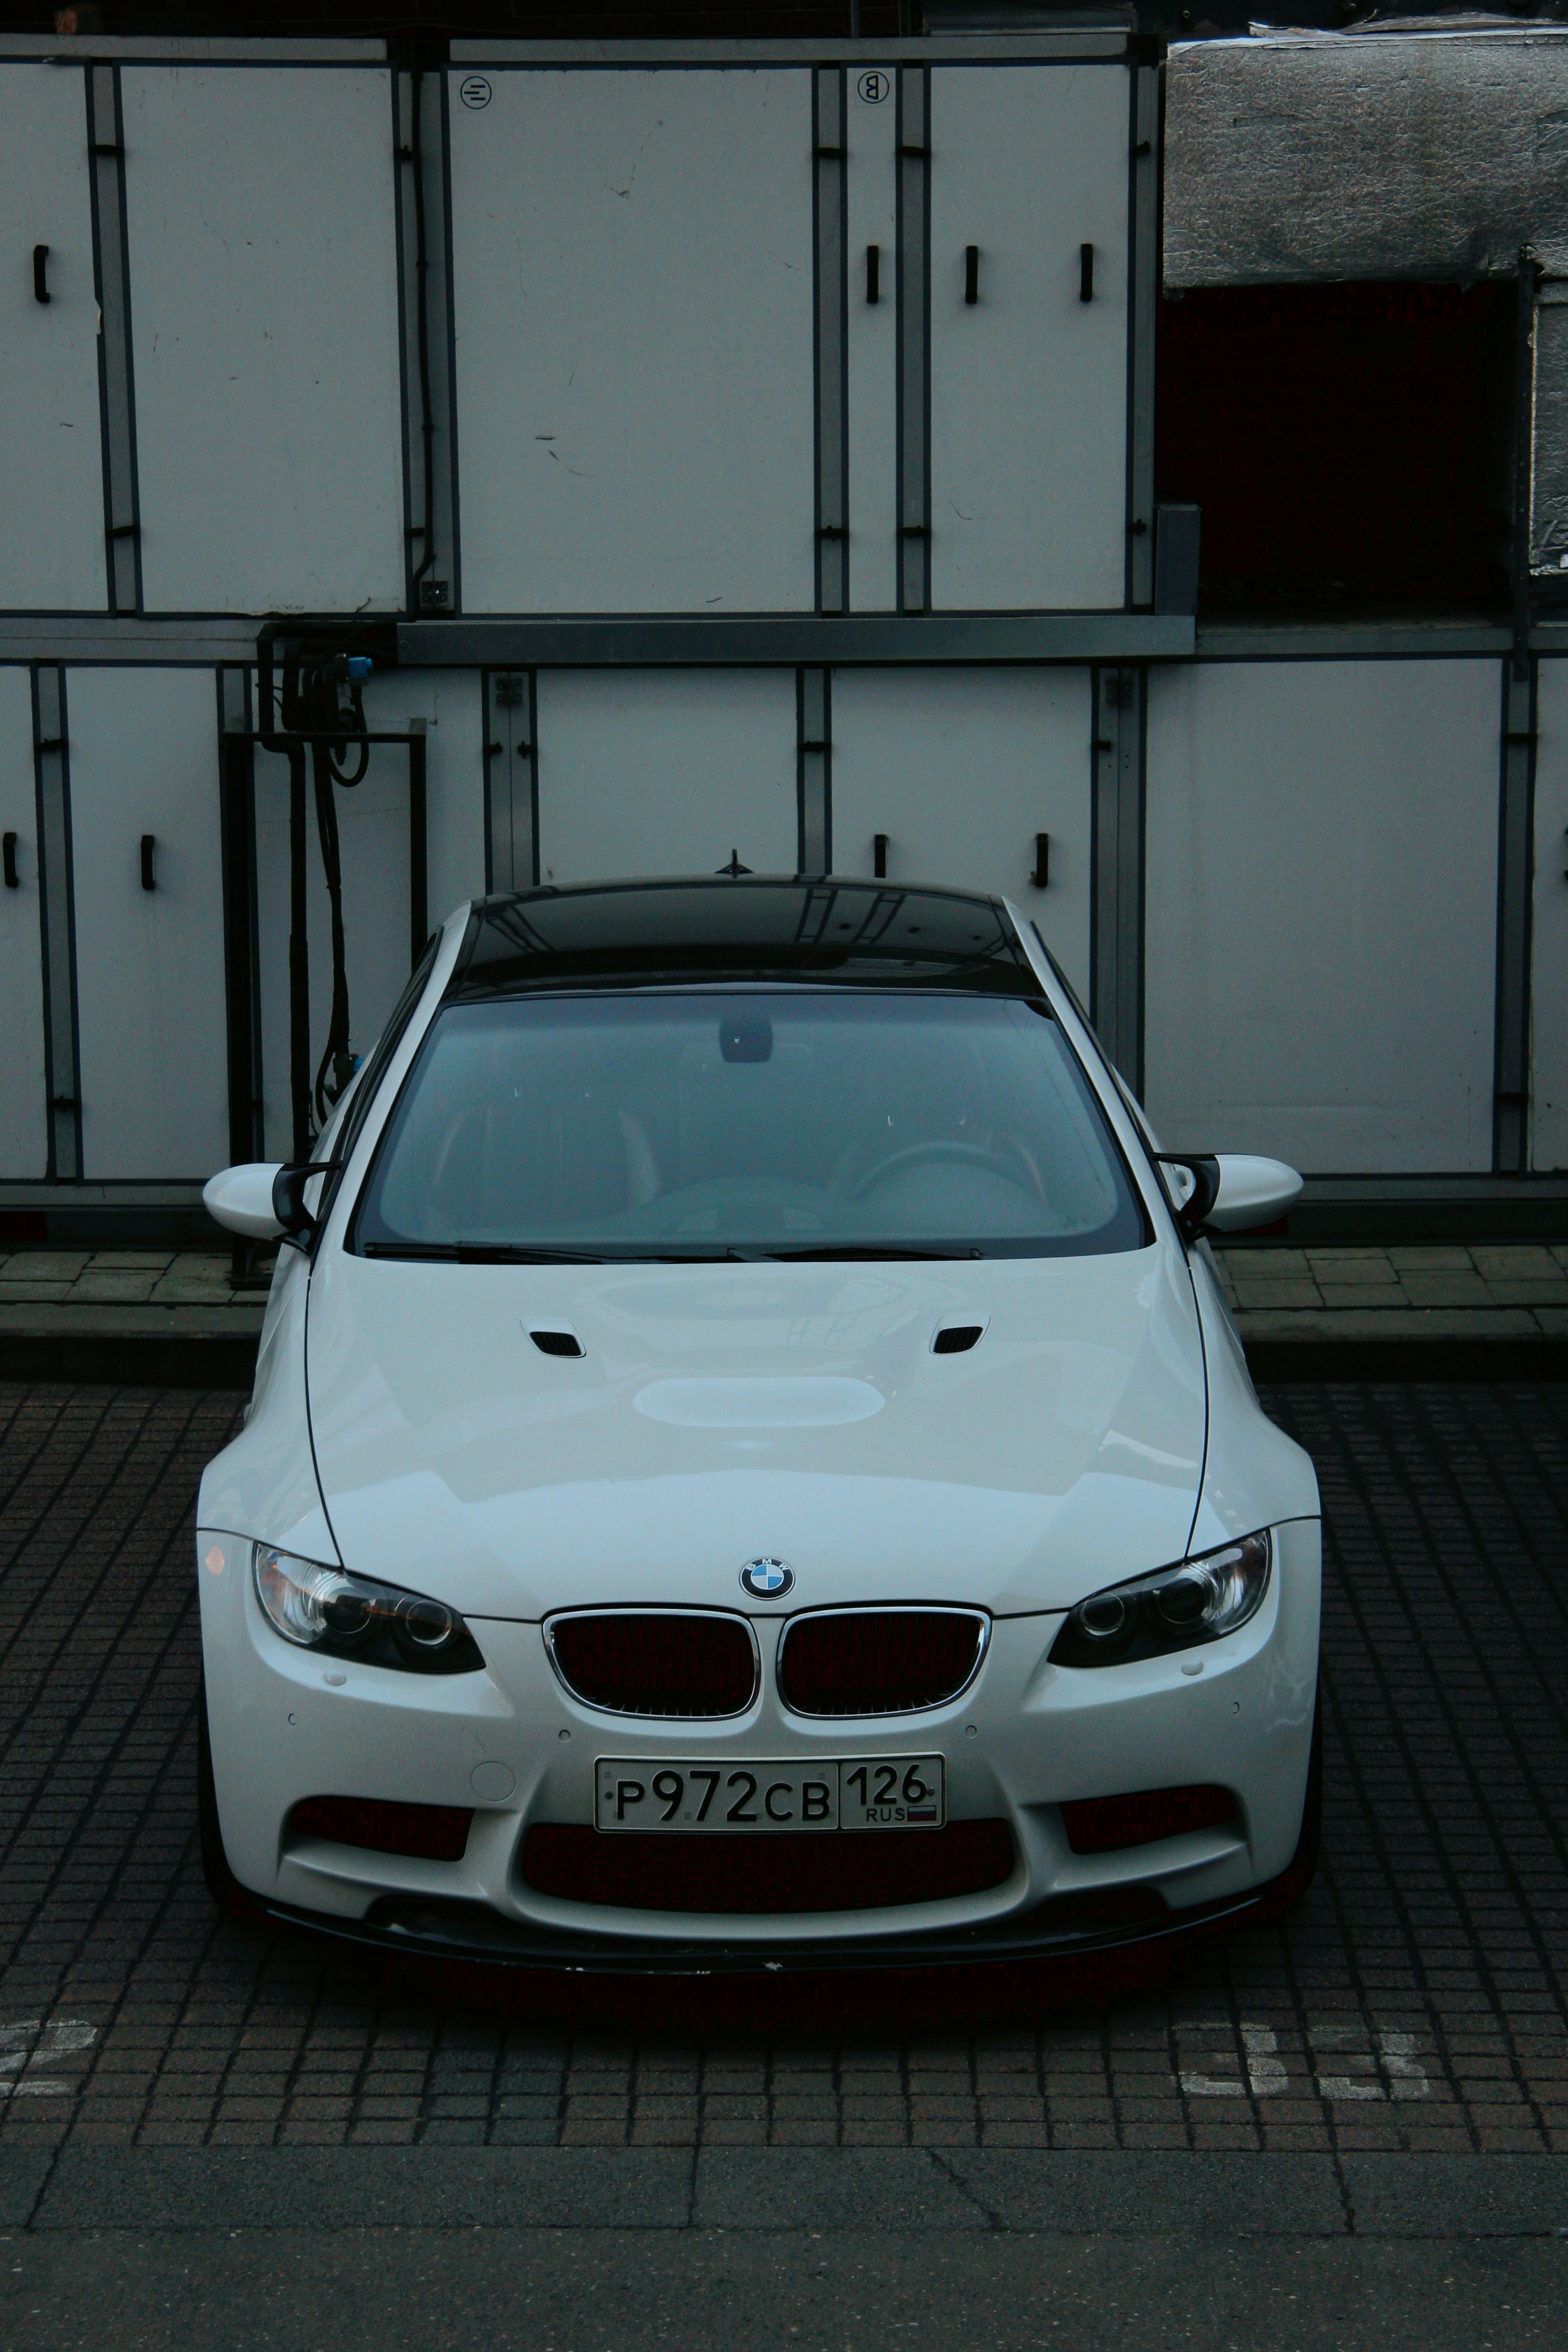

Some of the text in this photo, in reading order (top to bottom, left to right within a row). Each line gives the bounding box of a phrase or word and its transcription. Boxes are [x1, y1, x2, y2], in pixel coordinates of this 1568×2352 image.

[745, 1558, 790, 1571] BMW
[847, 1764, 927, 1805] 126
[866, 1808, 906, 1822] RUS
